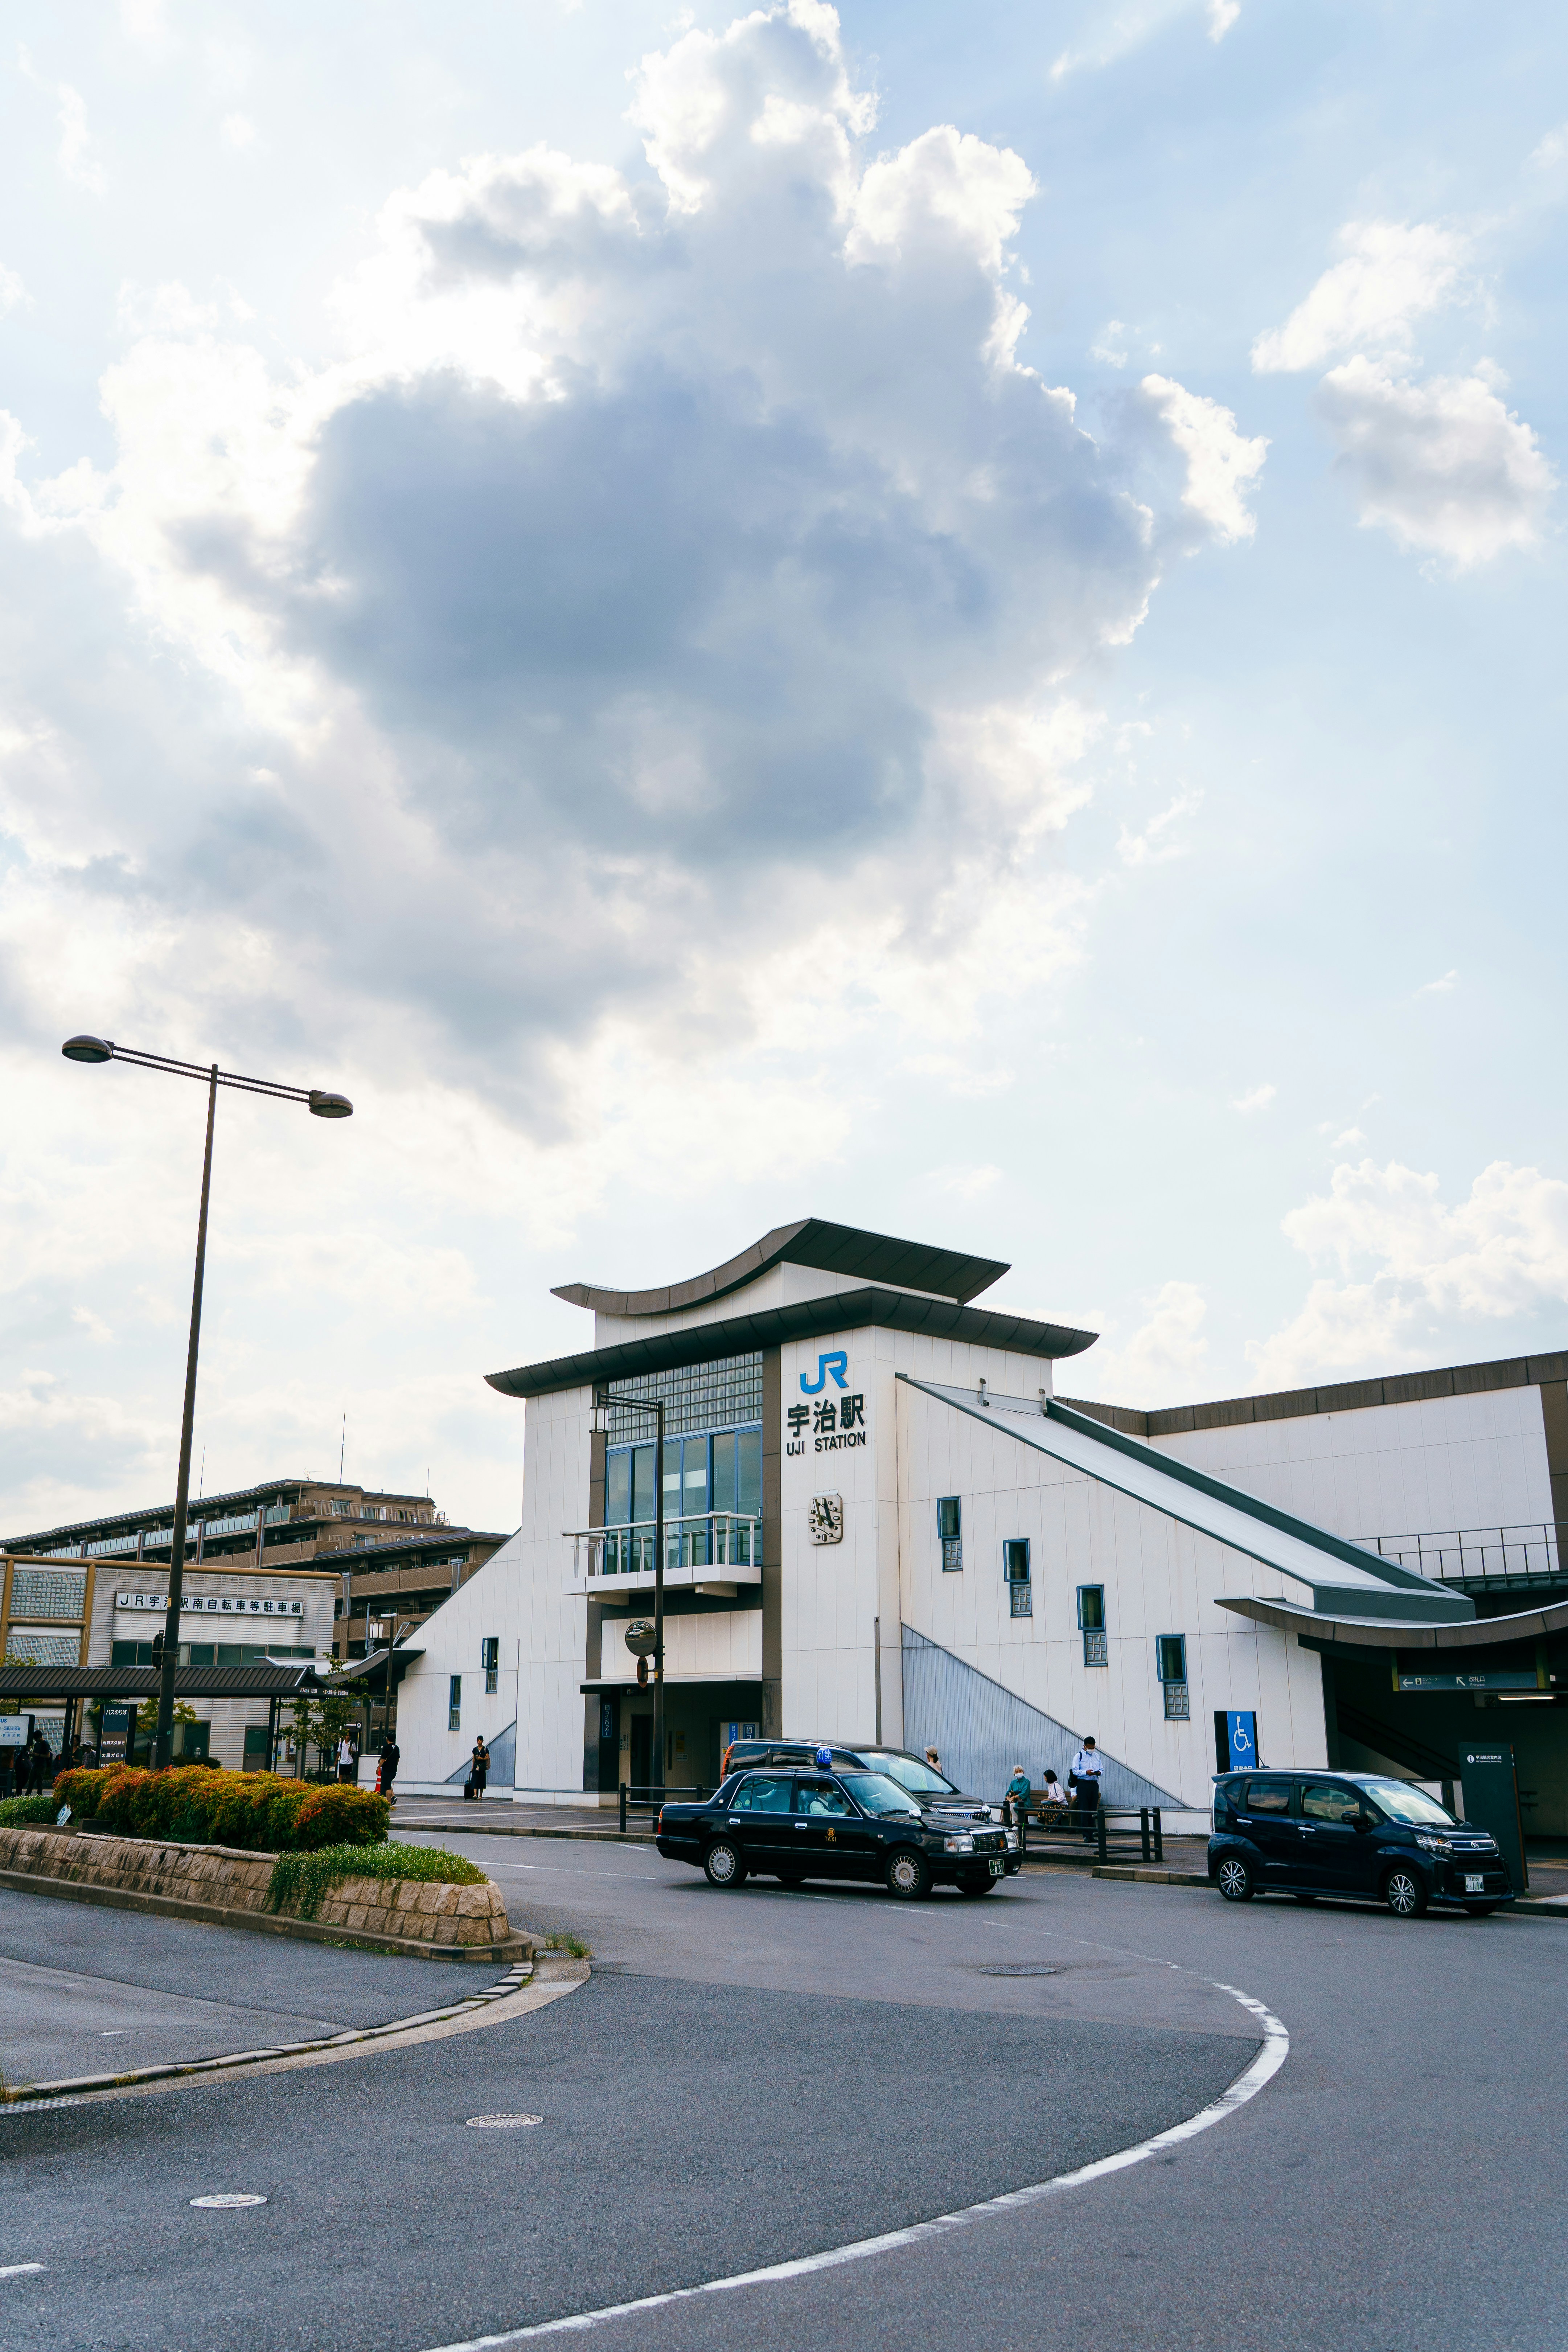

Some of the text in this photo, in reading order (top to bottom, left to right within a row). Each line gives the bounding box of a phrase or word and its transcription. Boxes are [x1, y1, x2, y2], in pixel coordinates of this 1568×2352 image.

[800, 1351, 849, 1394] JR
[787, 1394, 865, 1437] 宇治駅
[787, 1431, 866, 1456] UJI STATION
[824, 1750, 832, 1762] 第一
